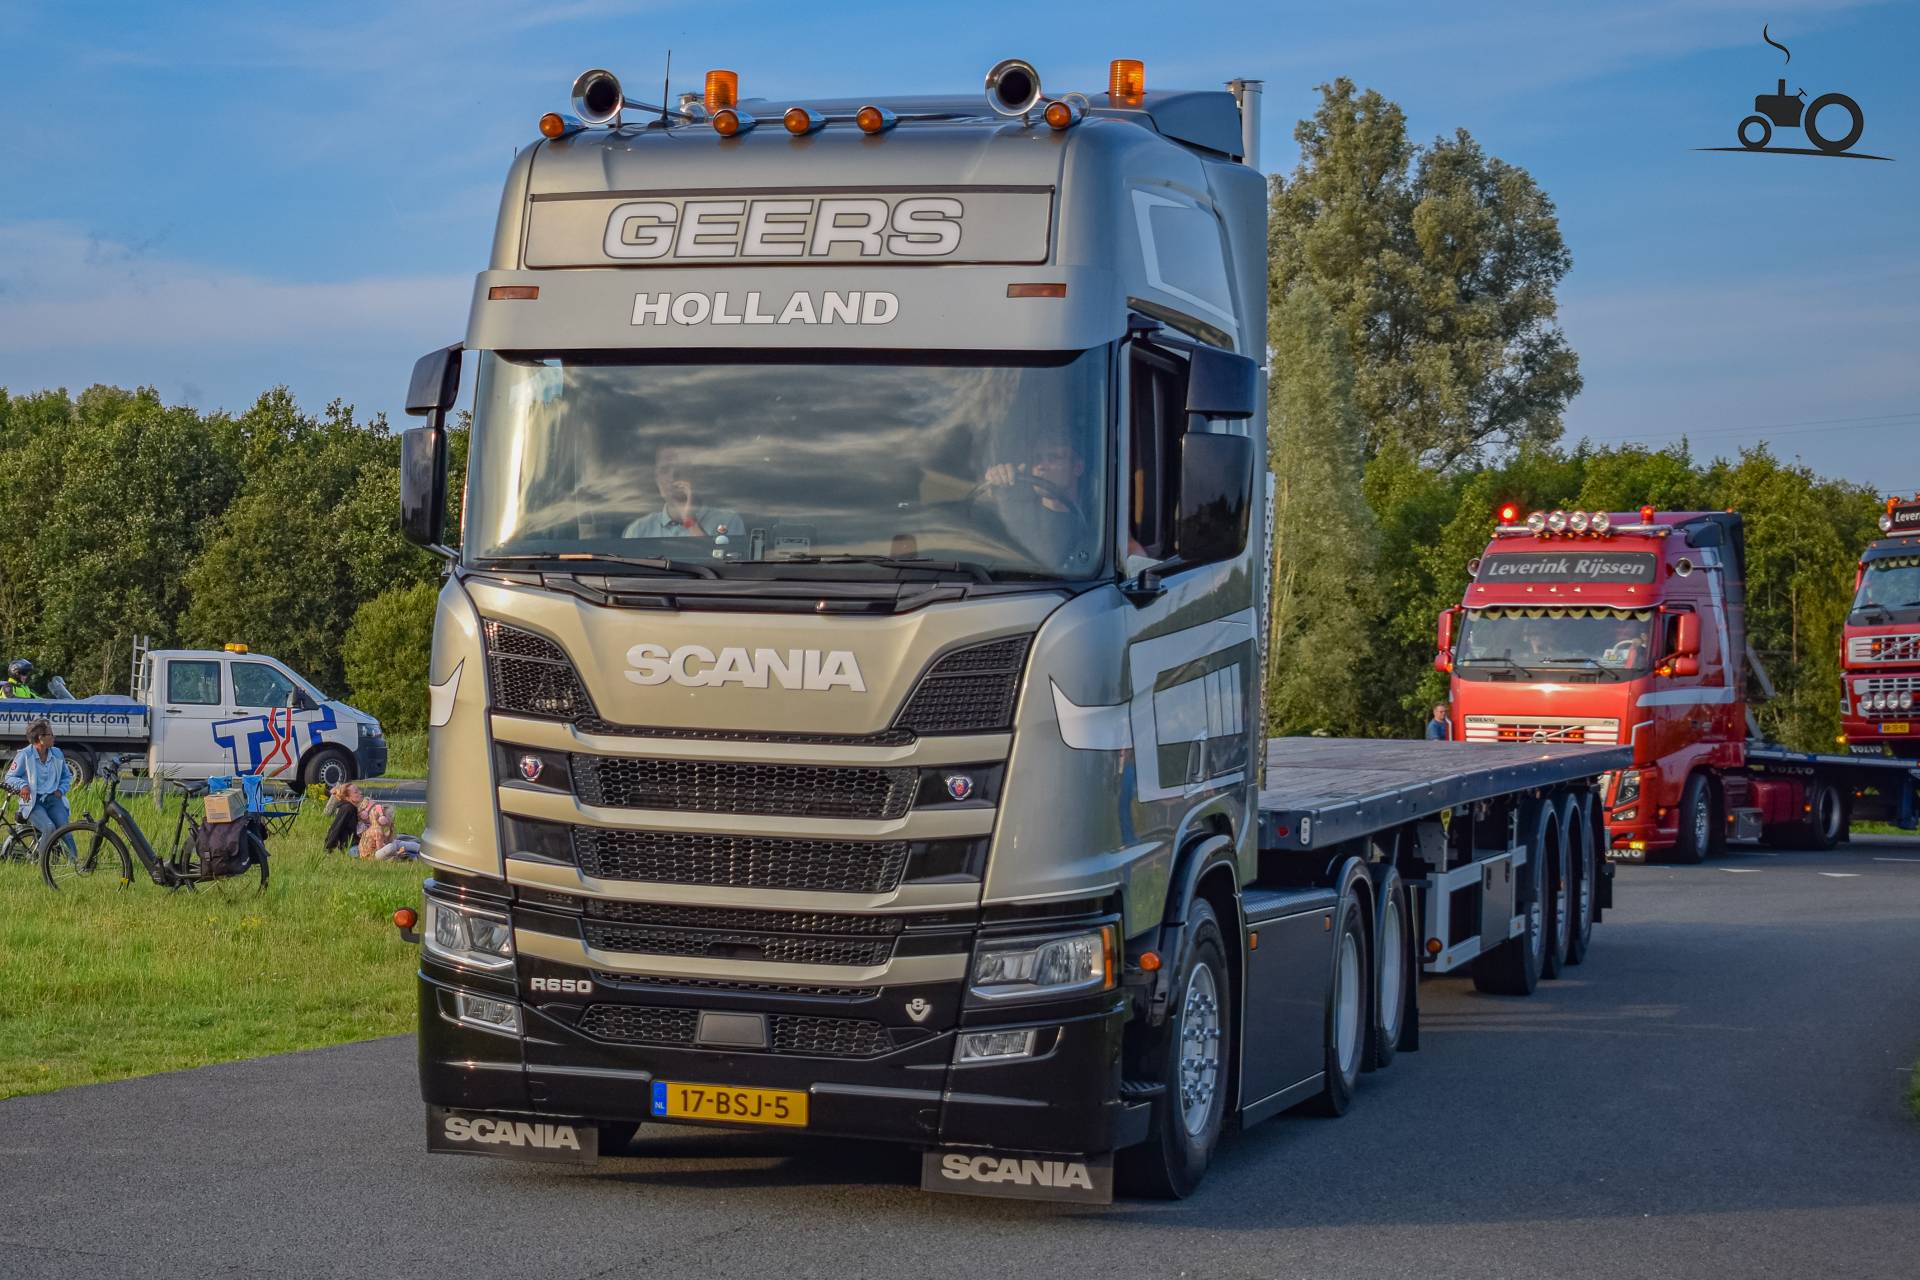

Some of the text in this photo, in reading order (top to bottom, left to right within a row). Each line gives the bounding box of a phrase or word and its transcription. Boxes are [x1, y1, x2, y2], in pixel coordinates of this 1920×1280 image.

[602, 197, 964, 259] GEERS
[630, 290, 900, 326] HOLLAND
[1488, 558, 1646, 577] Leverink Rijssen
[623, 643, 867, 692] SCANIA
[0, 711, 131, 724] wwwttcircuit.com
[1849, 744, 1882, 753] VOLVO
[1604, 849, 1641, 858] OLVO
[530, 977, 593, 993] R650
[654, 1101, 665, 1110] NL
[680, 1089, 790, 1119] 17-BSJ-5
[444, 1117, 581, 1150] SCANIA
[940, 1153, 1094, 1190] SCANIA
